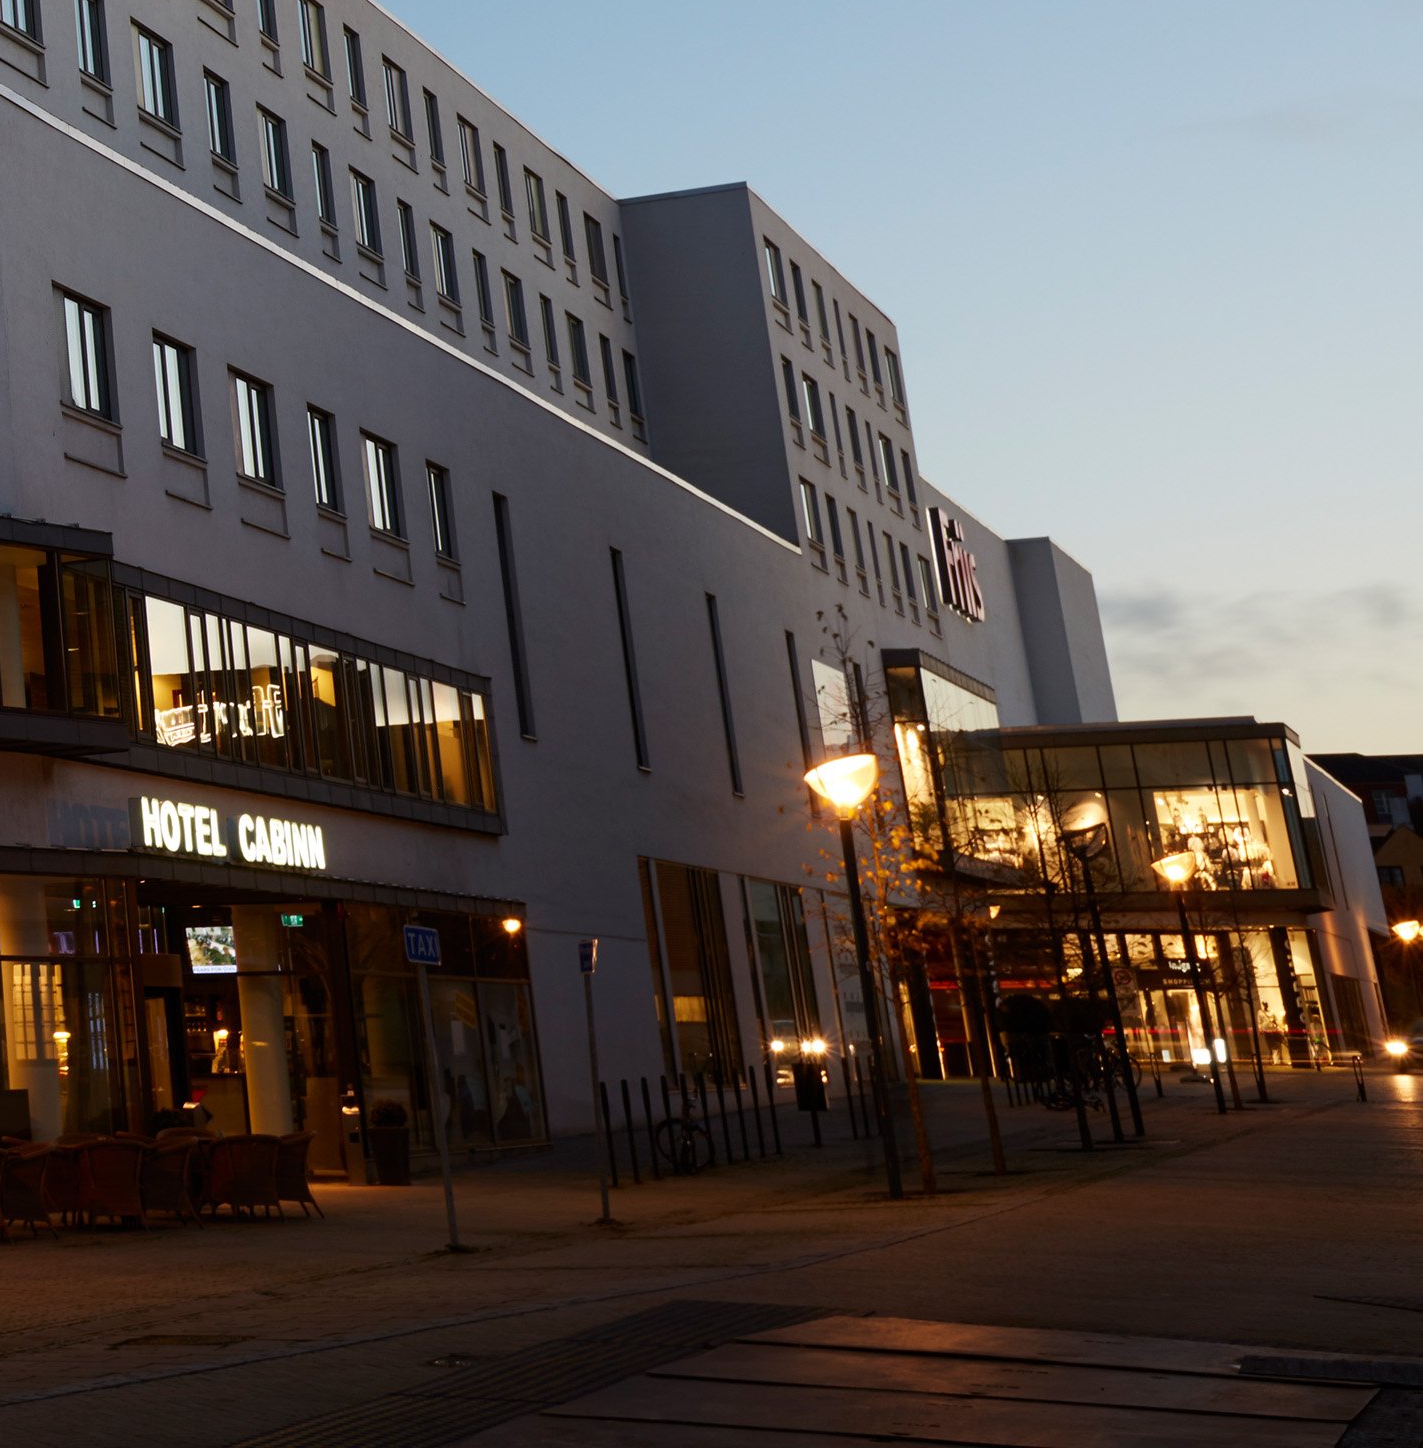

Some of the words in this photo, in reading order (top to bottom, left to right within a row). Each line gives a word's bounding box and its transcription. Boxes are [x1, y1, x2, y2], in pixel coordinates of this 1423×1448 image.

[141, 796, 227, 857] HOTEL
[238, 813, 326, 870] CABINN
[407, 932, 439, 958] TAXI
